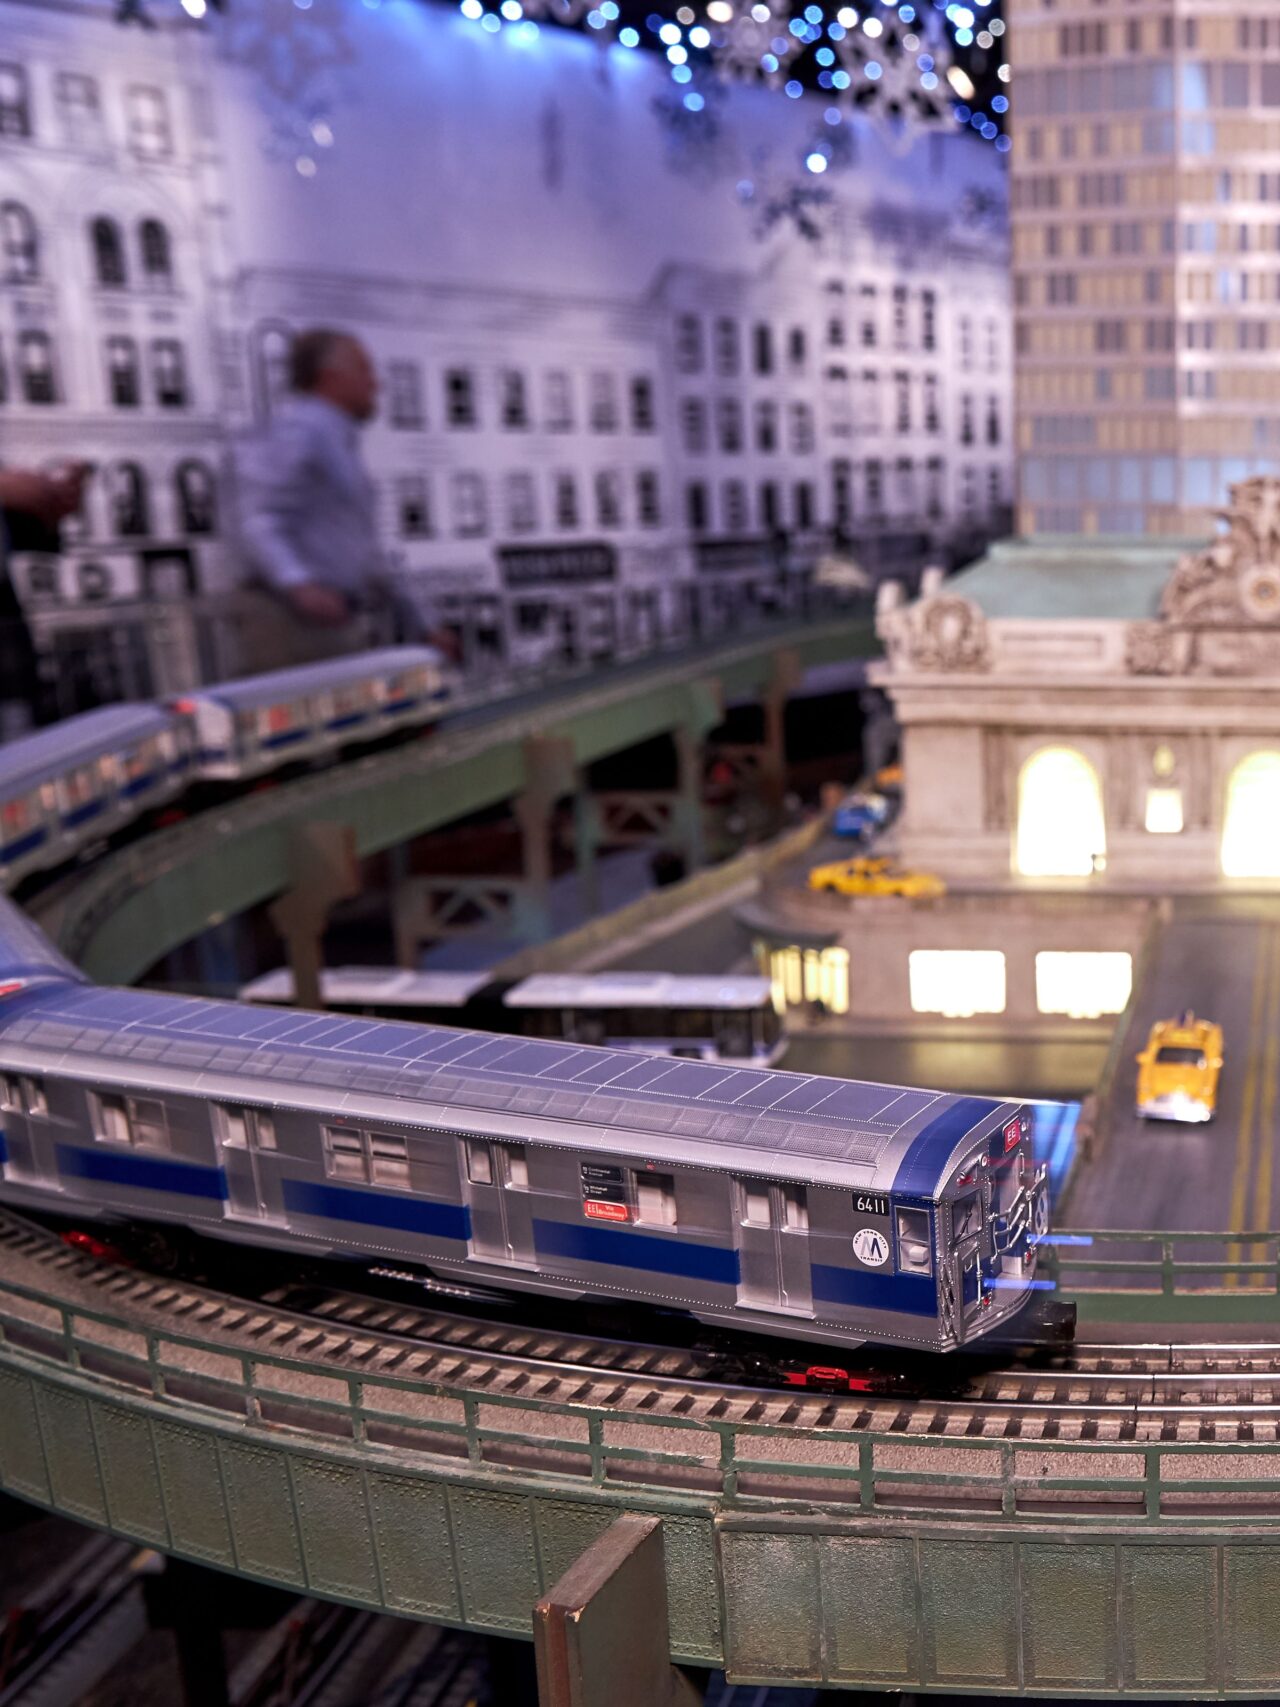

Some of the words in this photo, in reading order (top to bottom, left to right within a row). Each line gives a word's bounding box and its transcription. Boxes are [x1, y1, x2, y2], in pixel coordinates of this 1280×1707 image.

[1008, 1127, 1016, 1142] EE
[588, 1203, 596, 1213] EE
[857, 1197, 885, 1214] 6411
[598, 1209, 625, 1220] Broadway
[879, 1236, 887, 1249] CITY
